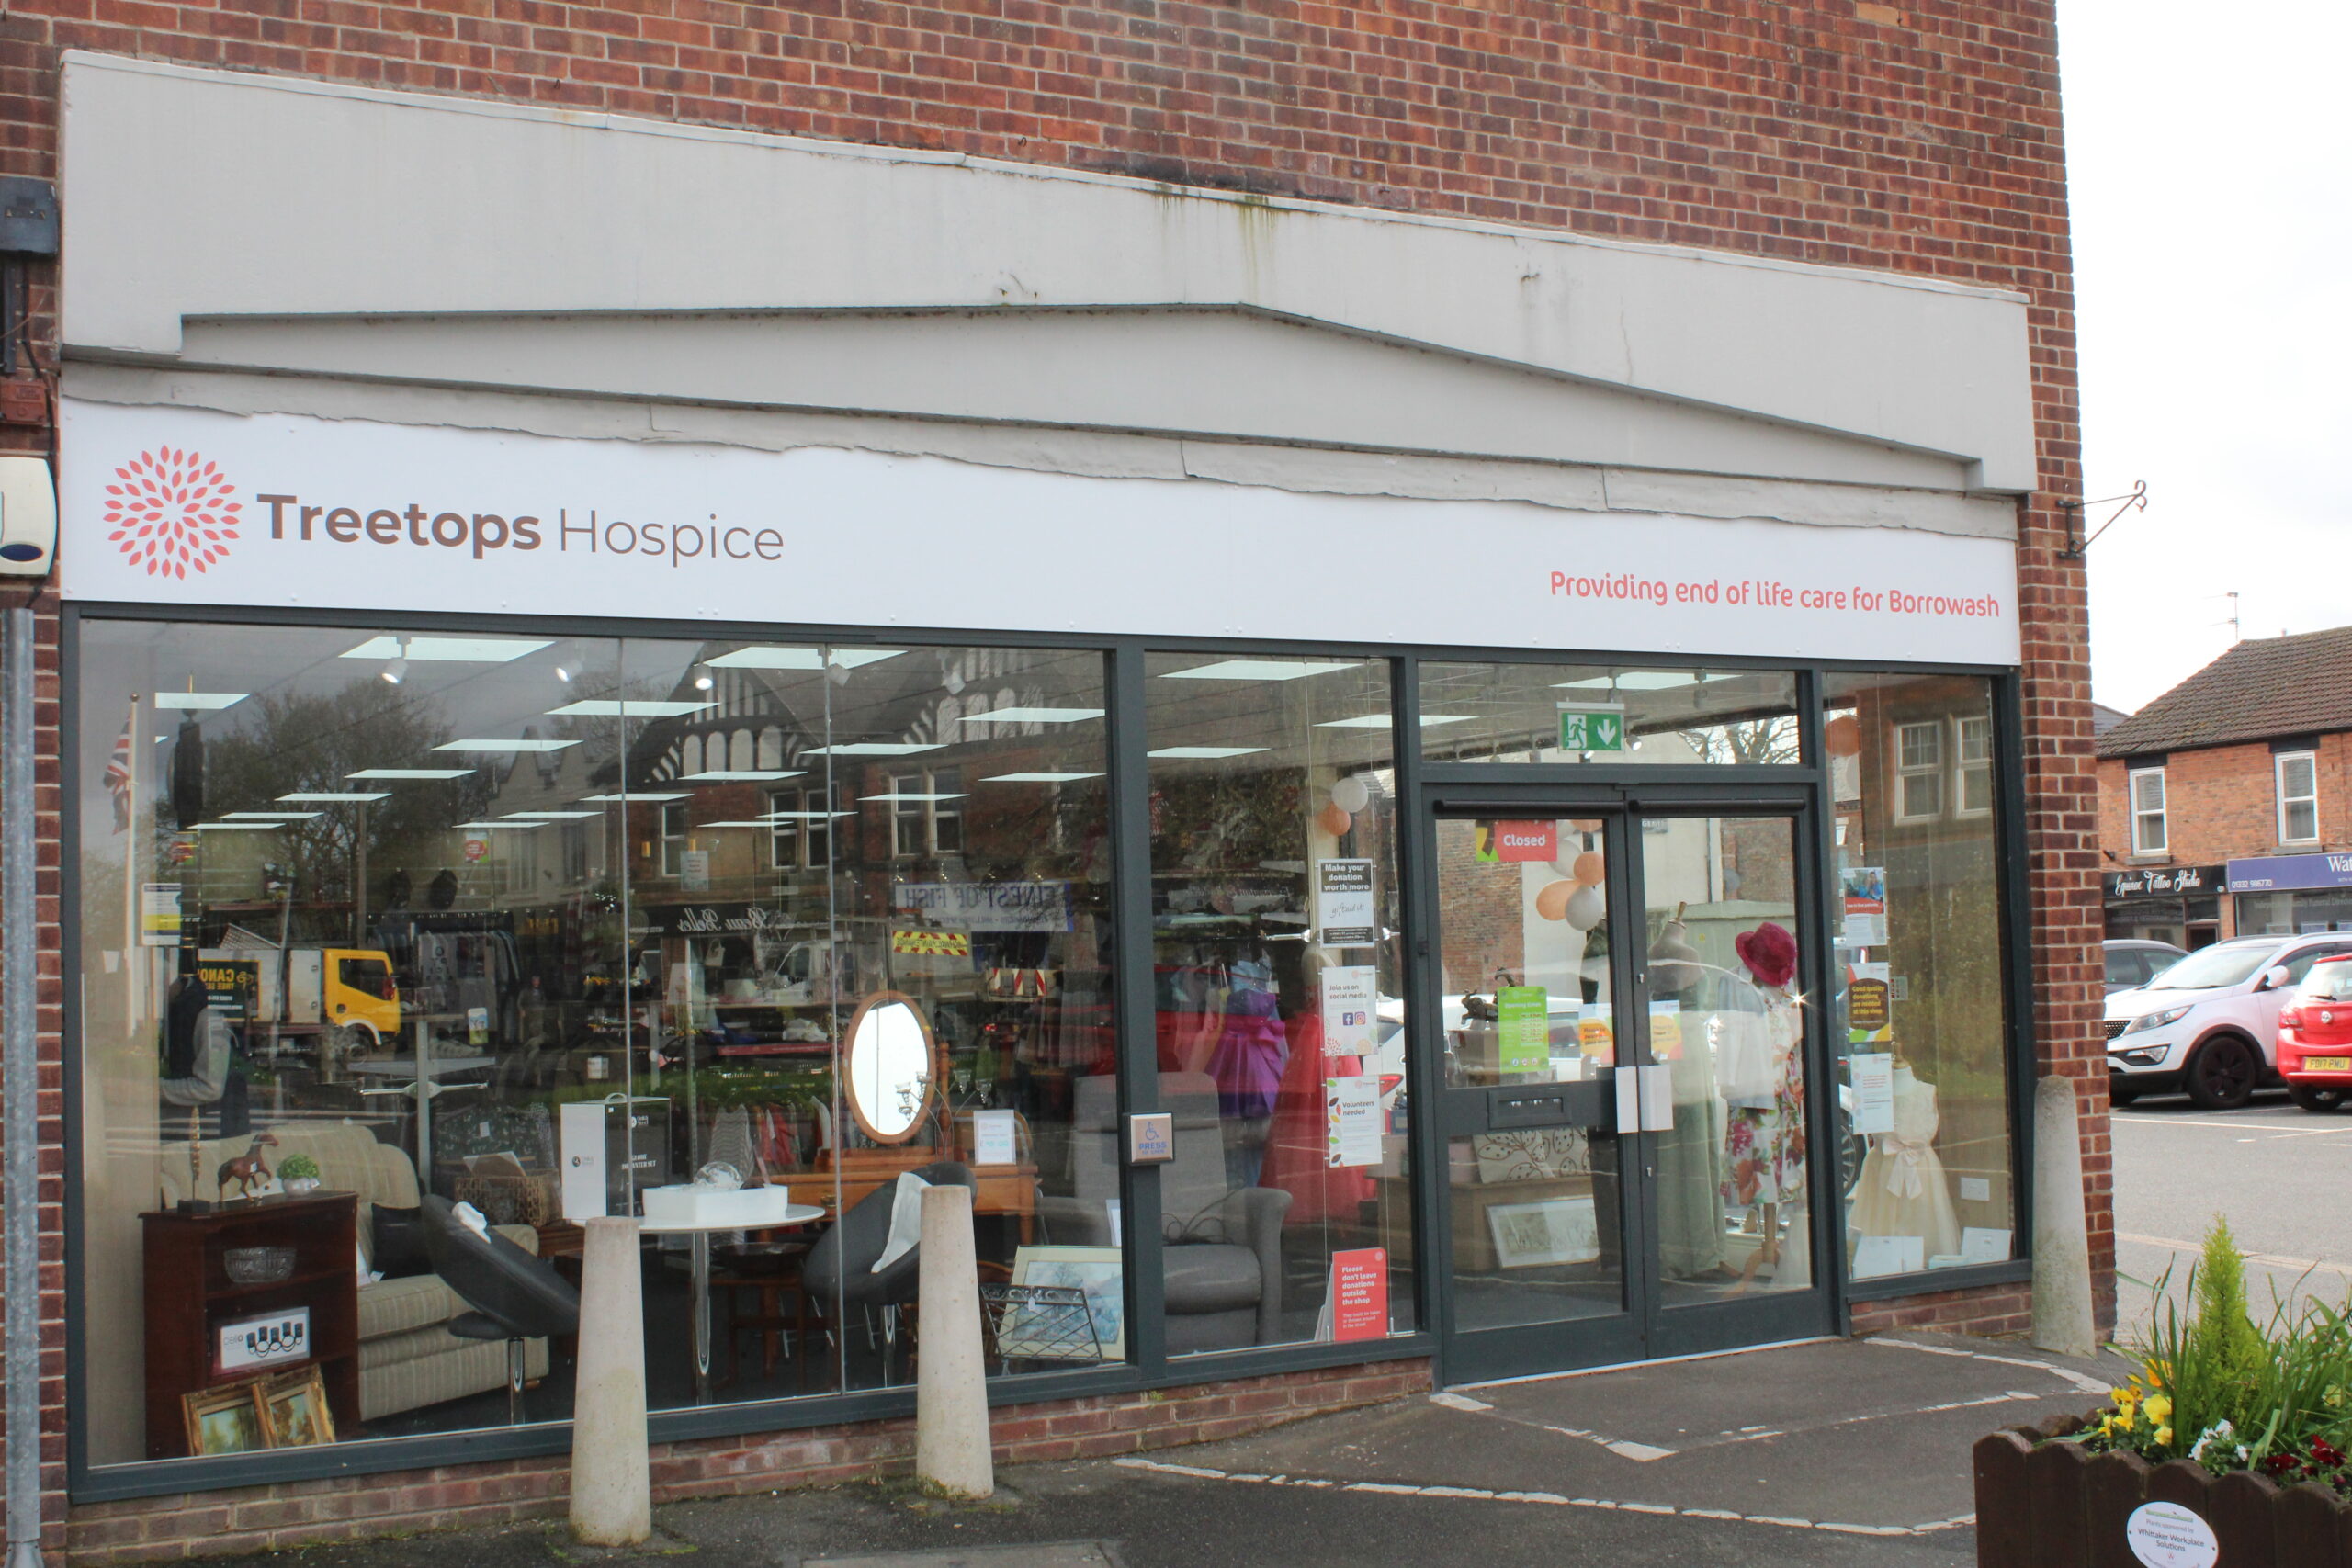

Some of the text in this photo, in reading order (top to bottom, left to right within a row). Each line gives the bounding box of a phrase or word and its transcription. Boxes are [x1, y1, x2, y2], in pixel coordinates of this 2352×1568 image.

[256, 493, 784, 568] Treetops Hospice
[1551, 570, 2000, 617] Providing end of life care for Borrowash
[1503, 834, 1546, 847] Closed
[1348, 864, 1365, 873] your
[1328, 873, 1363, 881] donation
[2143, 870, 2171, 893] Tattoo
[2173, 868, 2200, 892] Studio
[621, 1161, 647, 1170] DEANTER
[1342, 1281, 1374, 1290] donations
[2137, 1528, 2205, 1547] Whittaker Workplace
[2155, 1540, 2186, 1551] Solutions
